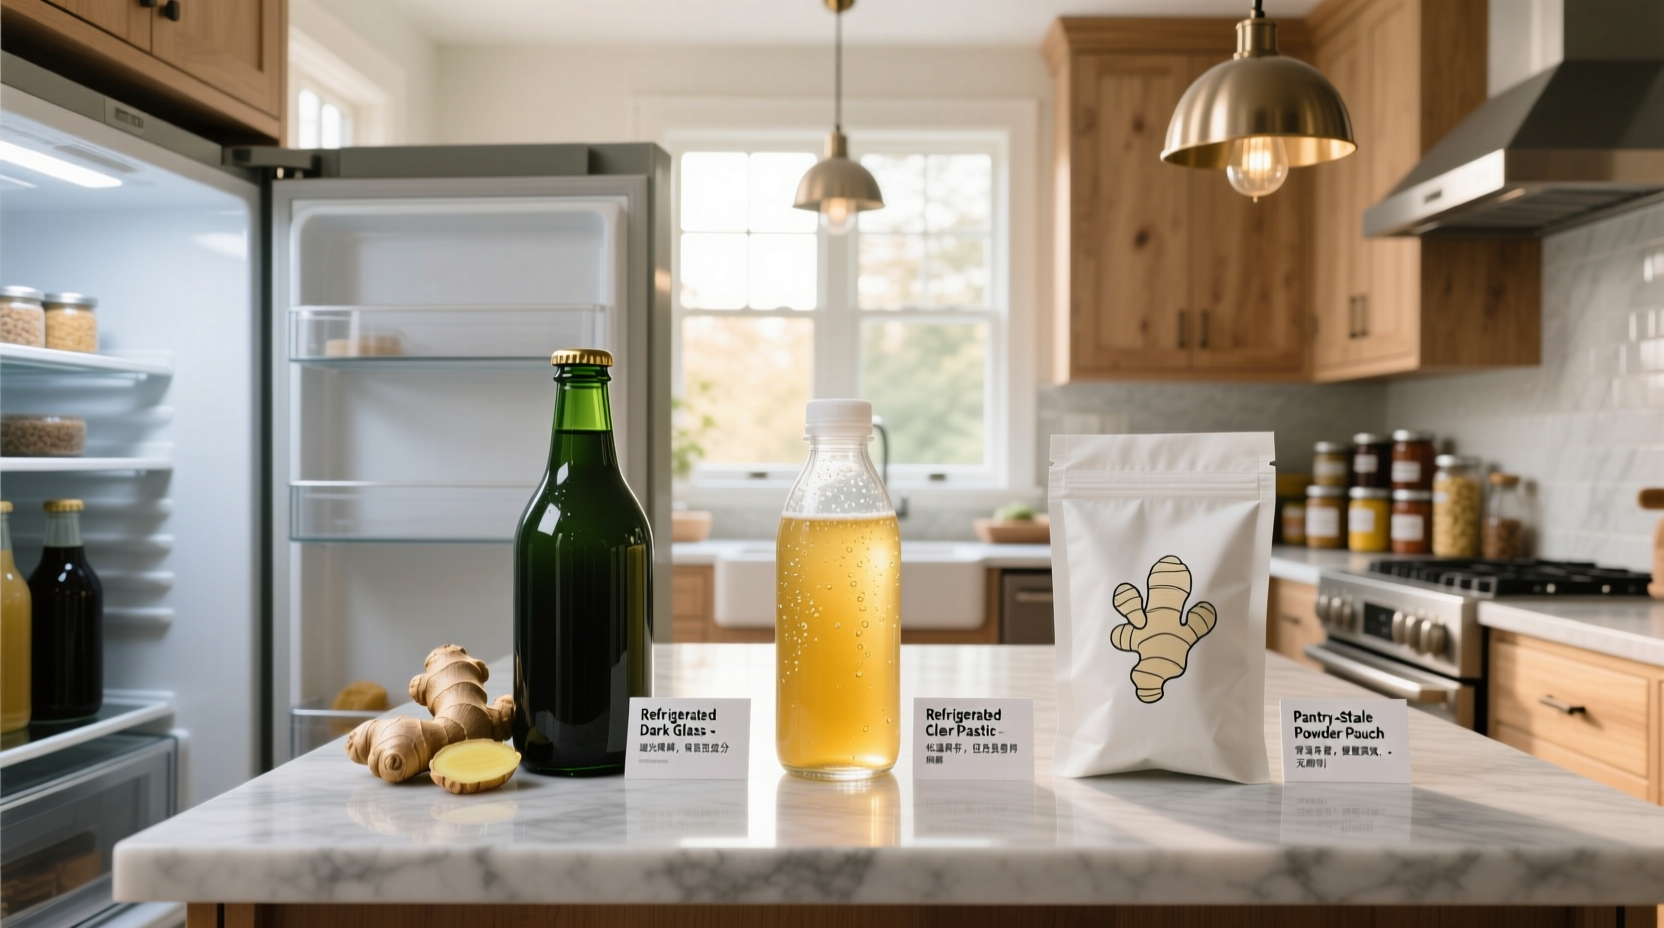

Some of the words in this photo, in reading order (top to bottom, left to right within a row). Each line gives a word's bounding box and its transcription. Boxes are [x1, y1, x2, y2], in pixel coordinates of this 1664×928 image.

[641, 708, 717, 724] Refrigerated
[640, 724, 670, 736] Dark
[1294, 726, 1343, 739] Powder
[1346, 726, 1385, 739] Pouch
